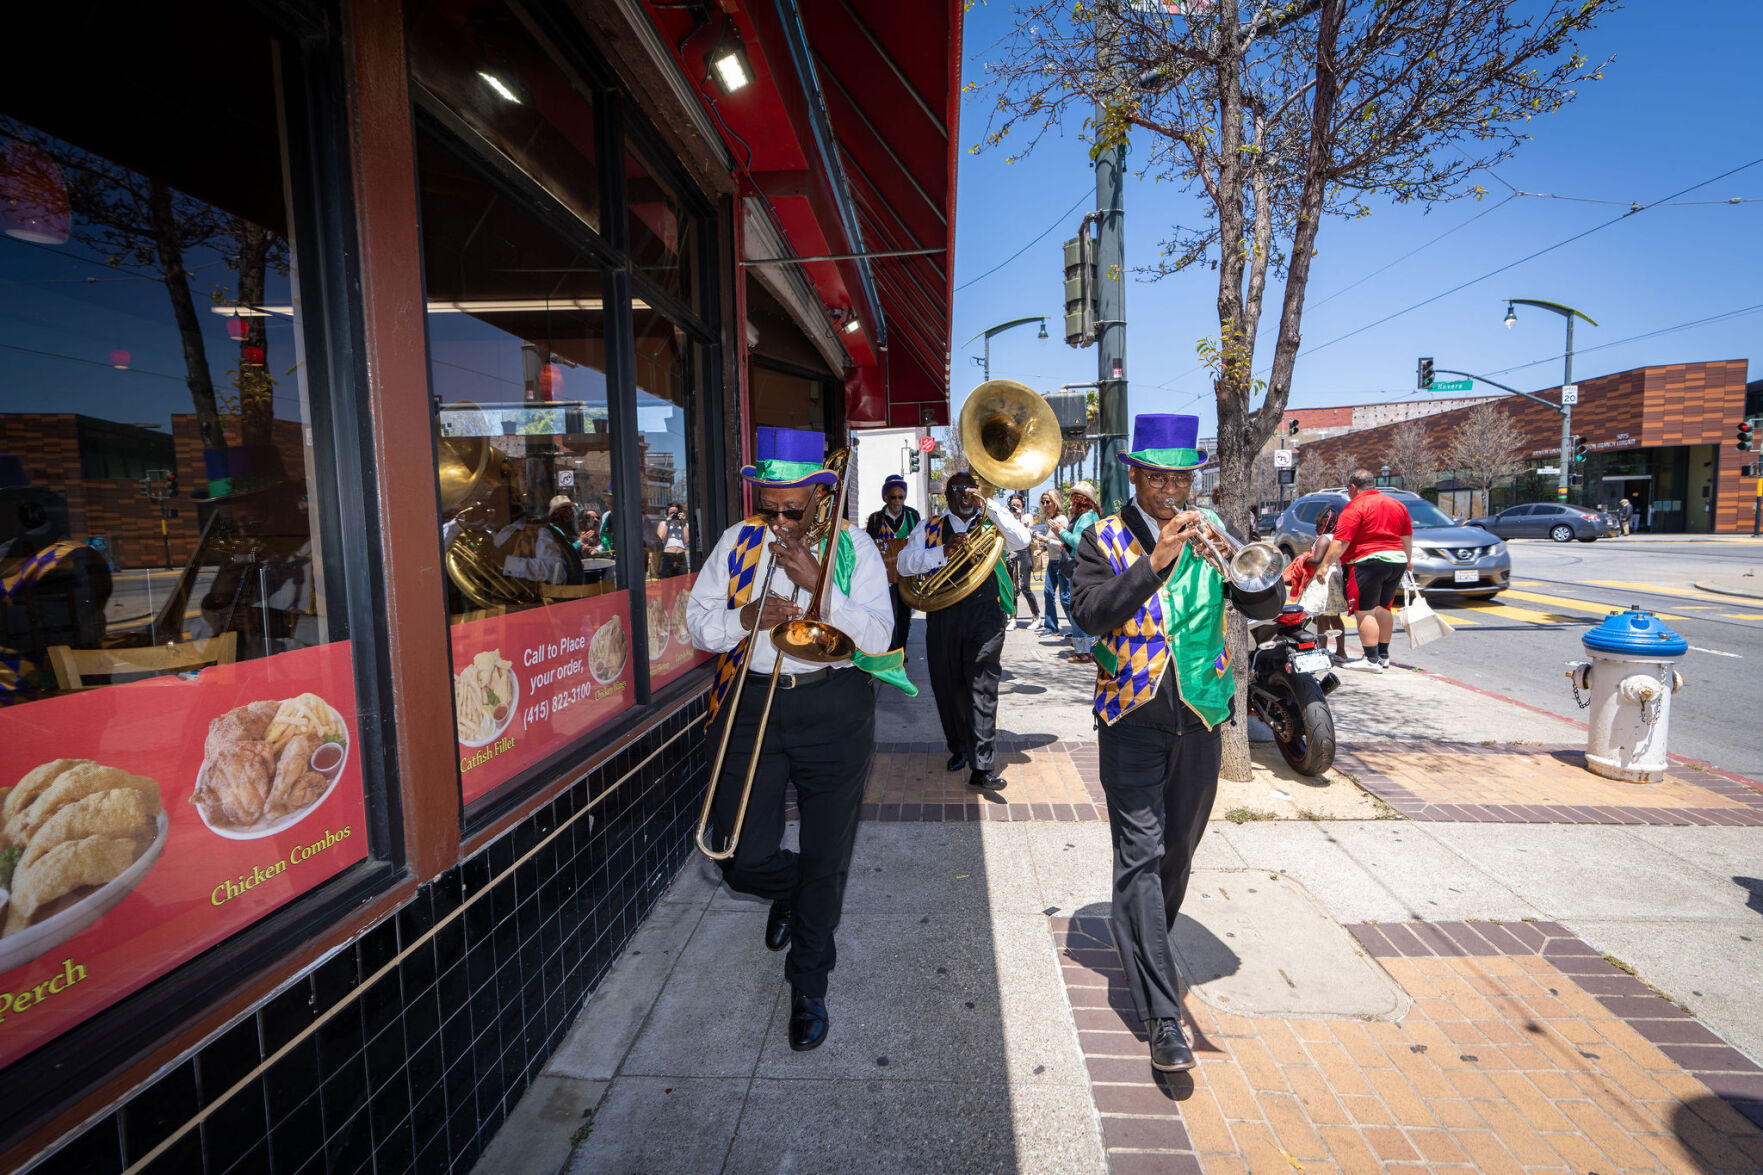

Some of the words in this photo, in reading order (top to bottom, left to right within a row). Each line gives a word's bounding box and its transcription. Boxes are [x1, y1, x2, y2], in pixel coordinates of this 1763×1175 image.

[524, 645, 545, 667] Call
[547, 644, 558, 659] to
[560, 635, 586, 655] Place
[530, 670, 554, 695] your
[556, 658, 584, 680] order,
[523, 699, 549, 731] (415)
[552, 681, 591, 713] 822-3100
[460, 747, 493, 773] Catfish
[494, 736, 516, 756] Fillet
[210, 858, 287, 907] Chicken
[290, 823, 352, 865] Combos
